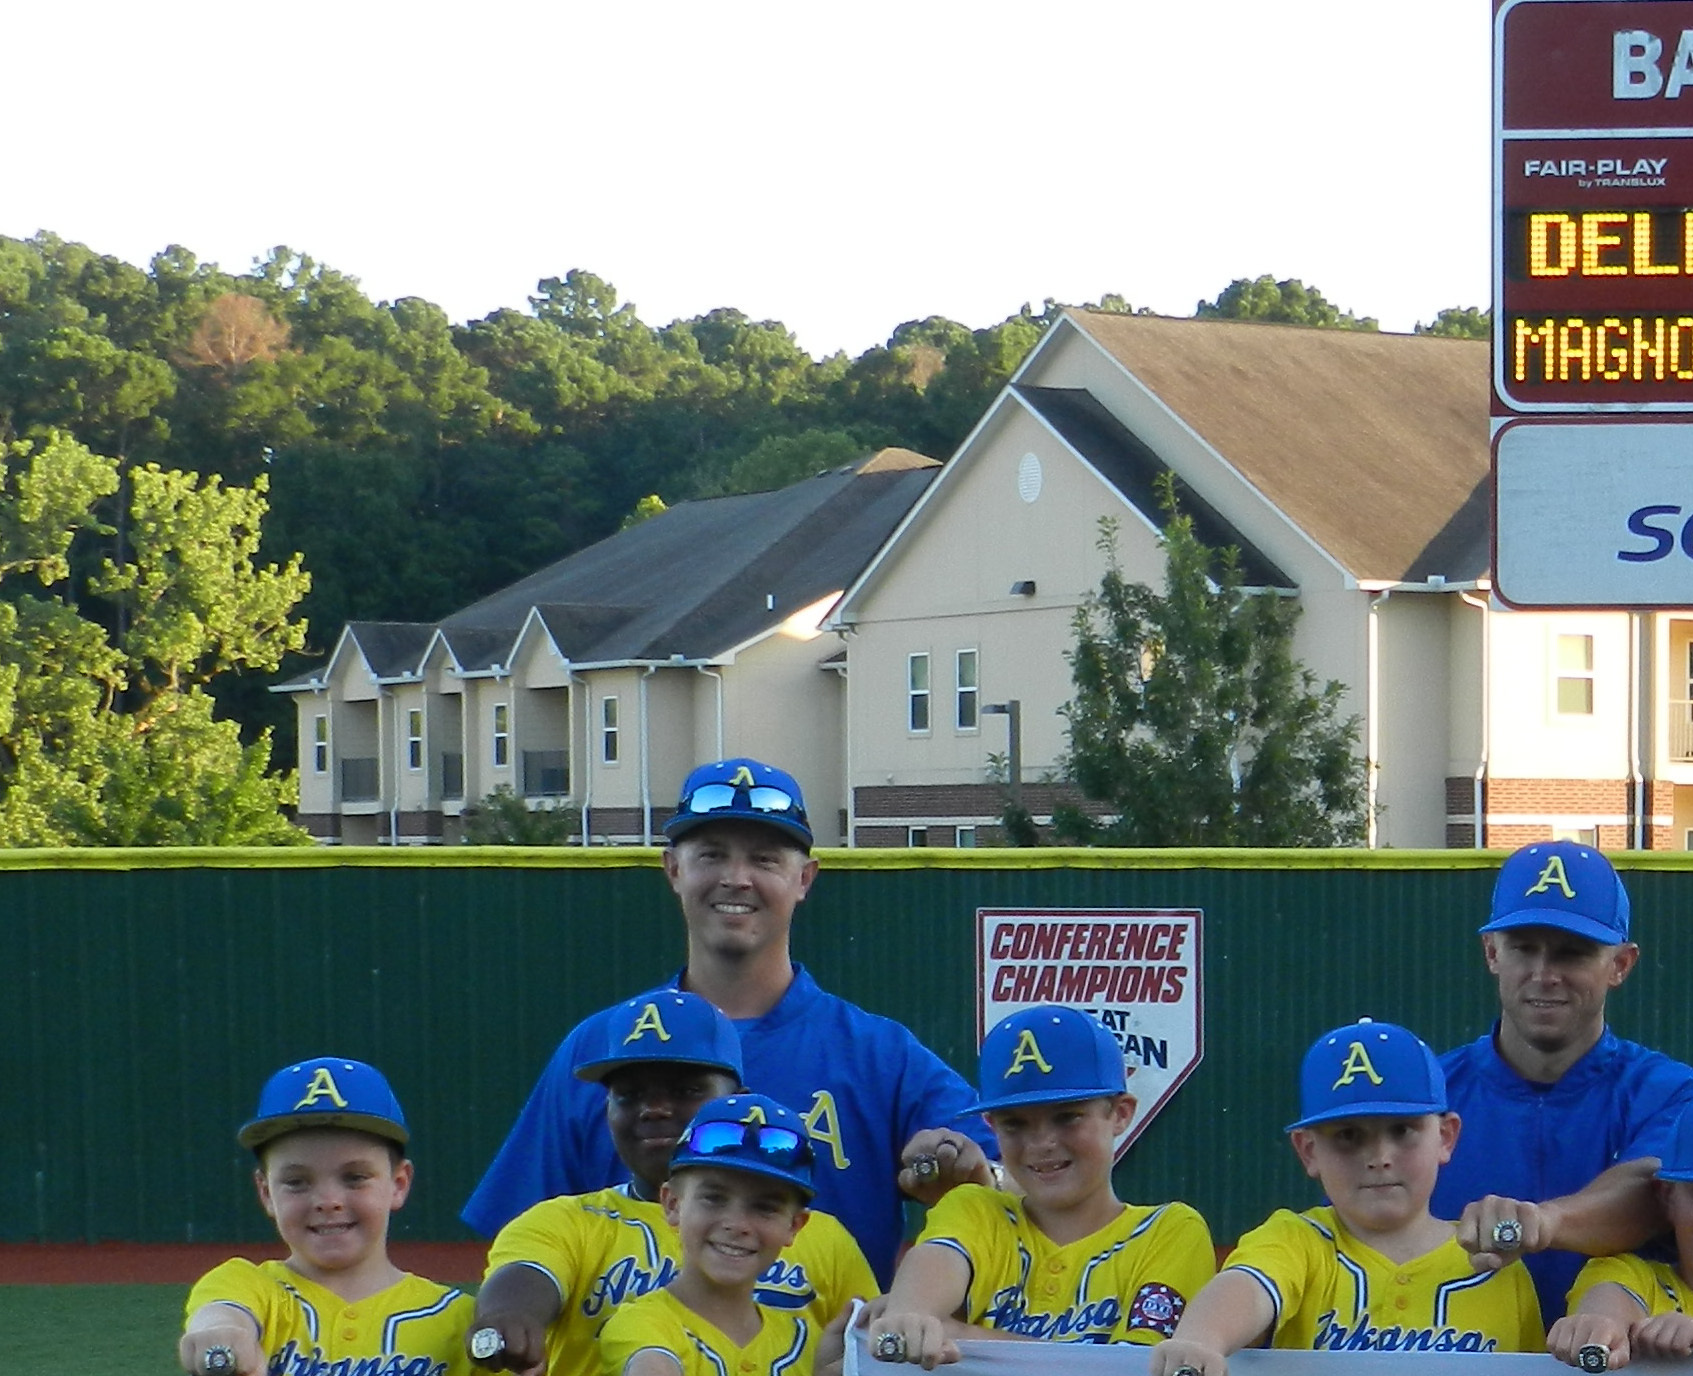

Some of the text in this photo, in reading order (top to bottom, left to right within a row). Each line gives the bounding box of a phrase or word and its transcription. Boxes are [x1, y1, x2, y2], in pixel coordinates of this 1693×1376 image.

[1524, 158, 1668, 177] FAIR-PLAY
[1578, 178, 1666, 188] by TRANSLUX
[1525, 856, 1576, 898] A
[990, 923, 1189, 961] CONFERENCE
[991, 965, 1188, 1003] CHAMPIONS
[623, 1003, 671, 1046] A
[1004, 1030, 1053, 1079] A
[1332, 1042, 1383, 1091] A
[294, 1068, 348, 1110] A
